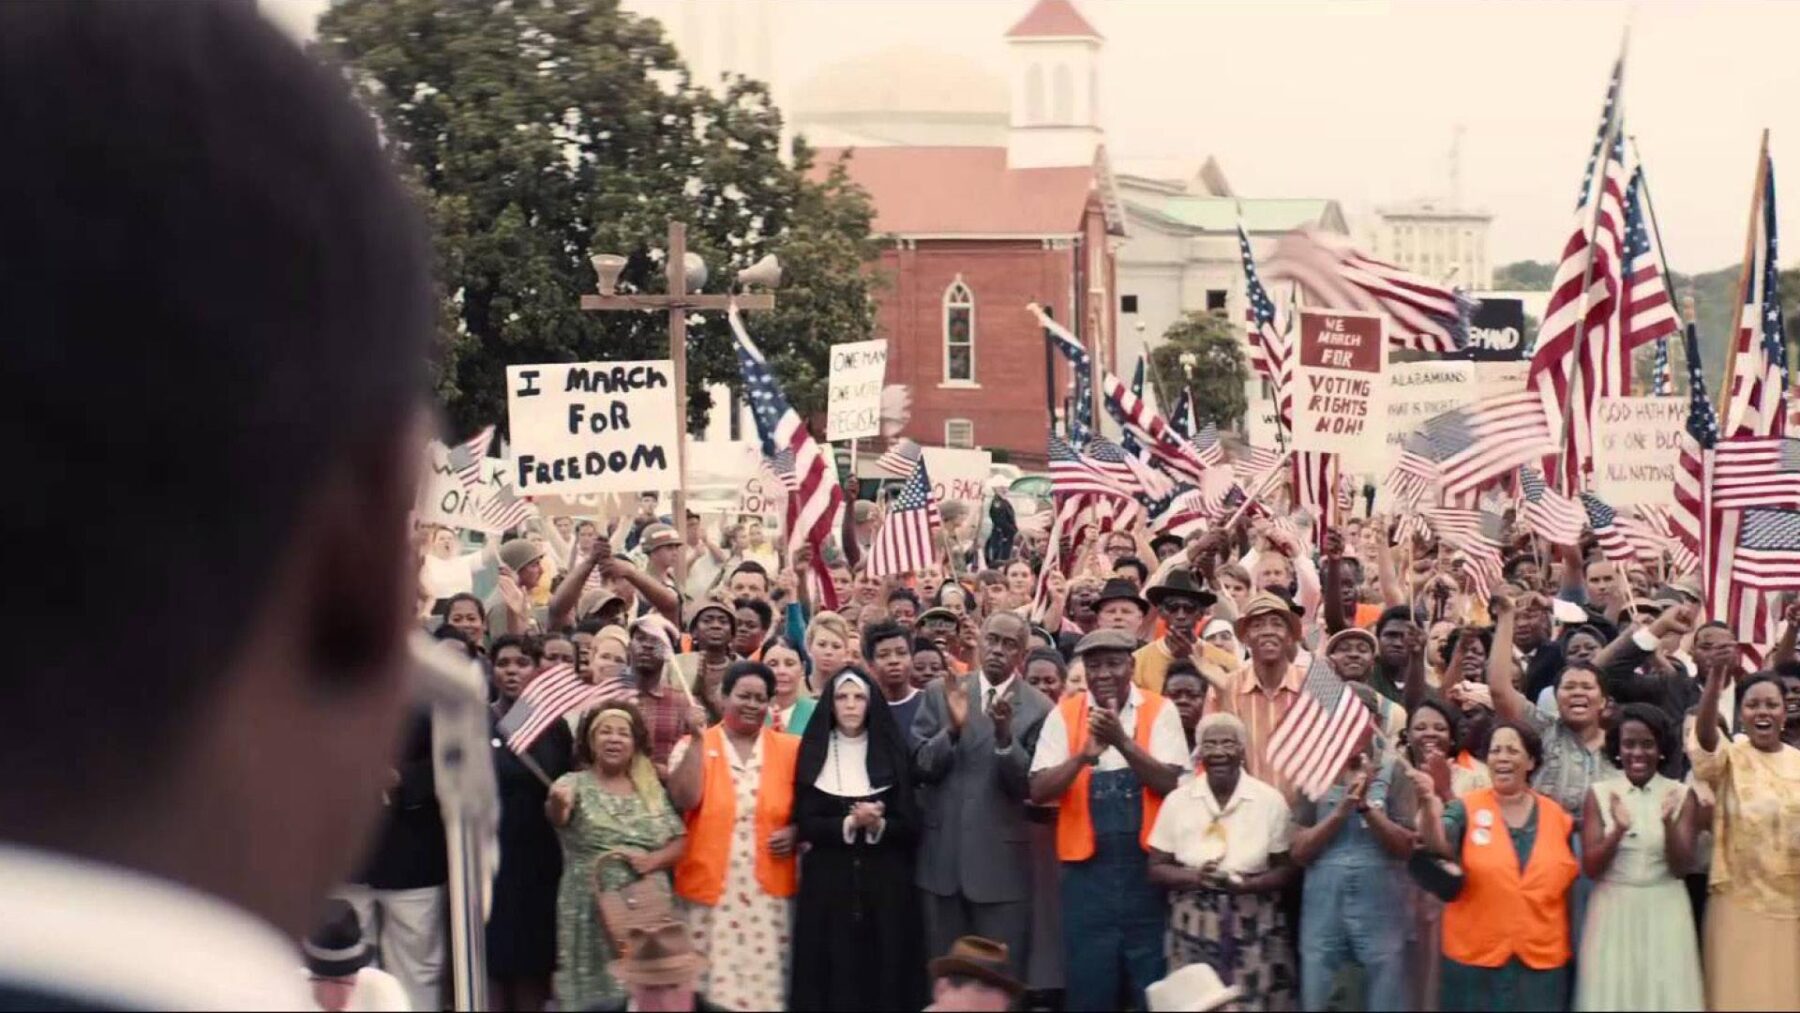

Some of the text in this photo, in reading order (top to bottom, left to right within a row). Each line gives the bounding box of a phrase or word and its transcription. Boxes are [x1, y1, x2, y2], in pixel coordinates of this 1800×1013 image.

[1325, 318, 1344, 331] WE
[1317, 330, 1361, 346] MARCH
[1468, 326, 1519, 351] EMAND
[1320, 348, 1353, 367] FOR
[517, 370, 540, 397] I
[1308, 374, 1370, 397] VOTING
[1308, 395, 1367, 416] RIGHTS
[518, 444, 667, 488] FREEDOM
